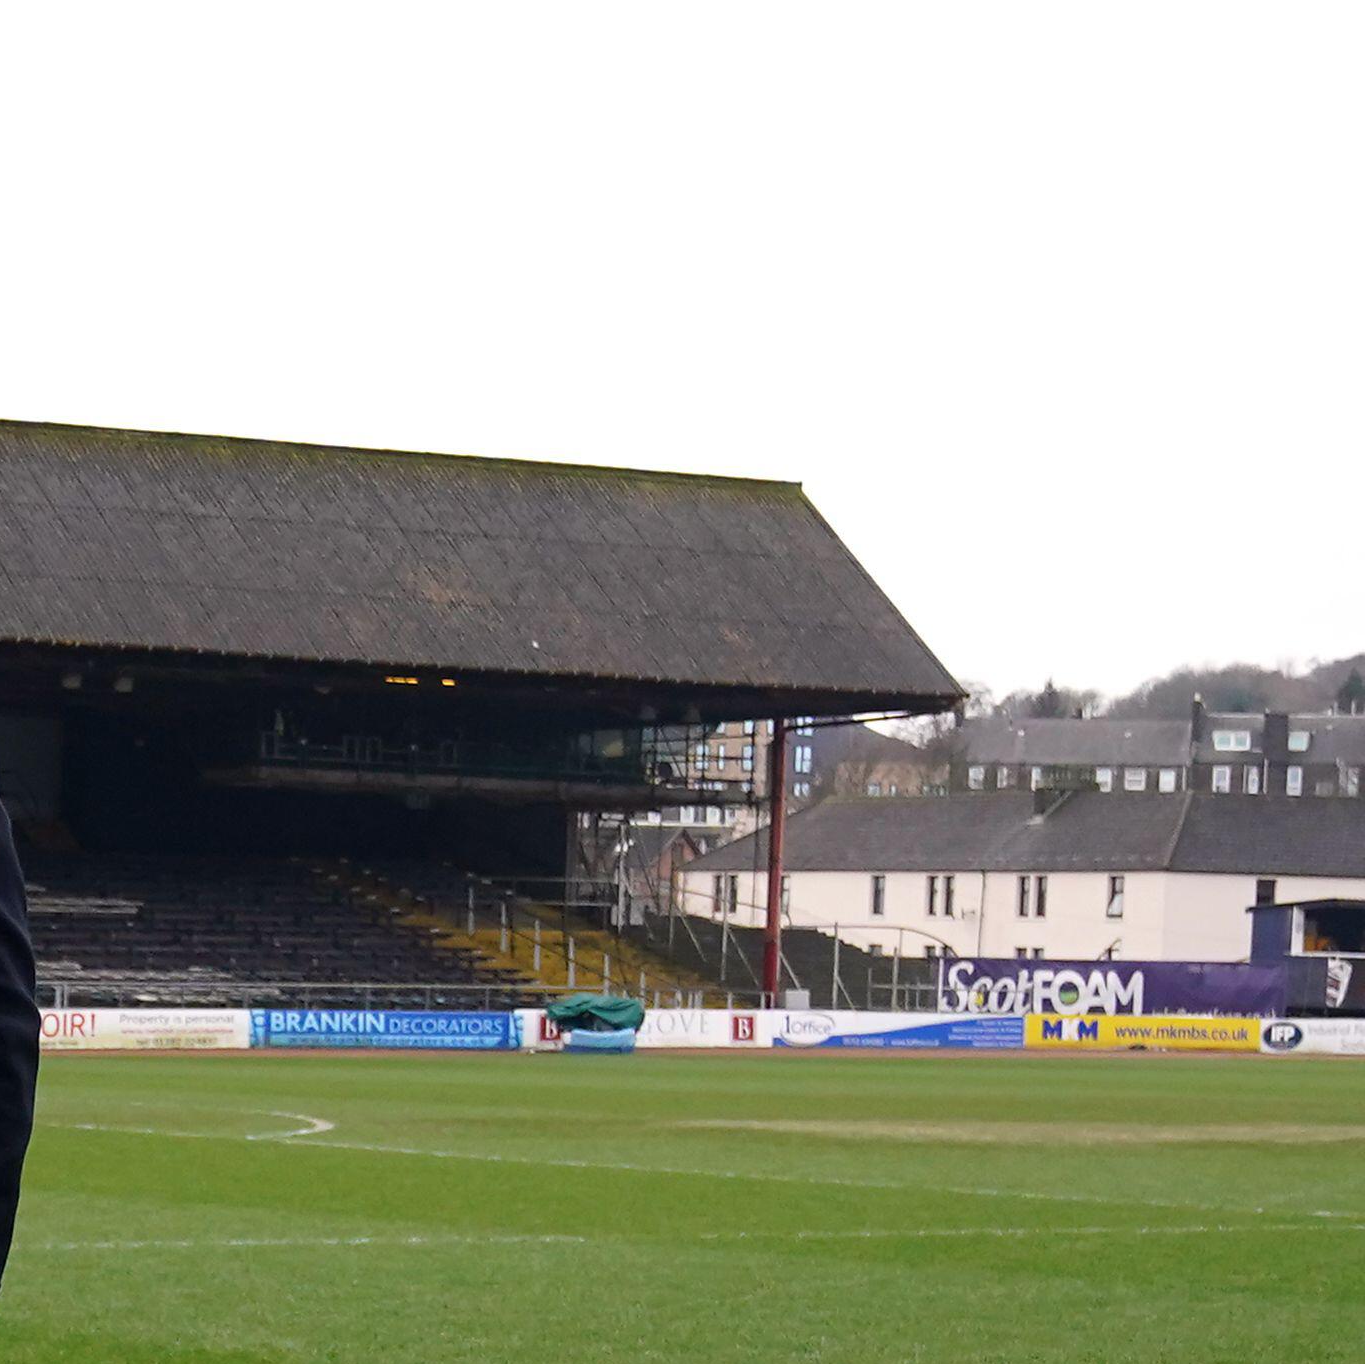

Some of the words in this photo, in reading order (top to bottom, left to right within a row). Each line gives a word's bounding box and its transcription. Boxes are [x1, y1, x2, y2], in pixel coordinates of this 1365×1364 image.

[119, 1013, 170, 1026] Property
[185, 1014, 235, 1026] personal
[269, 1012, 385, 1034] BRANKIN
[389, 1018, 504, 1036] DECORATORS
[1042, 1018, 1099, 1041] MKM
[1115, 1024, 1249, 1042] www.mkmbs.co.uk
[1270, 1026, 1296, 1043] IFP
